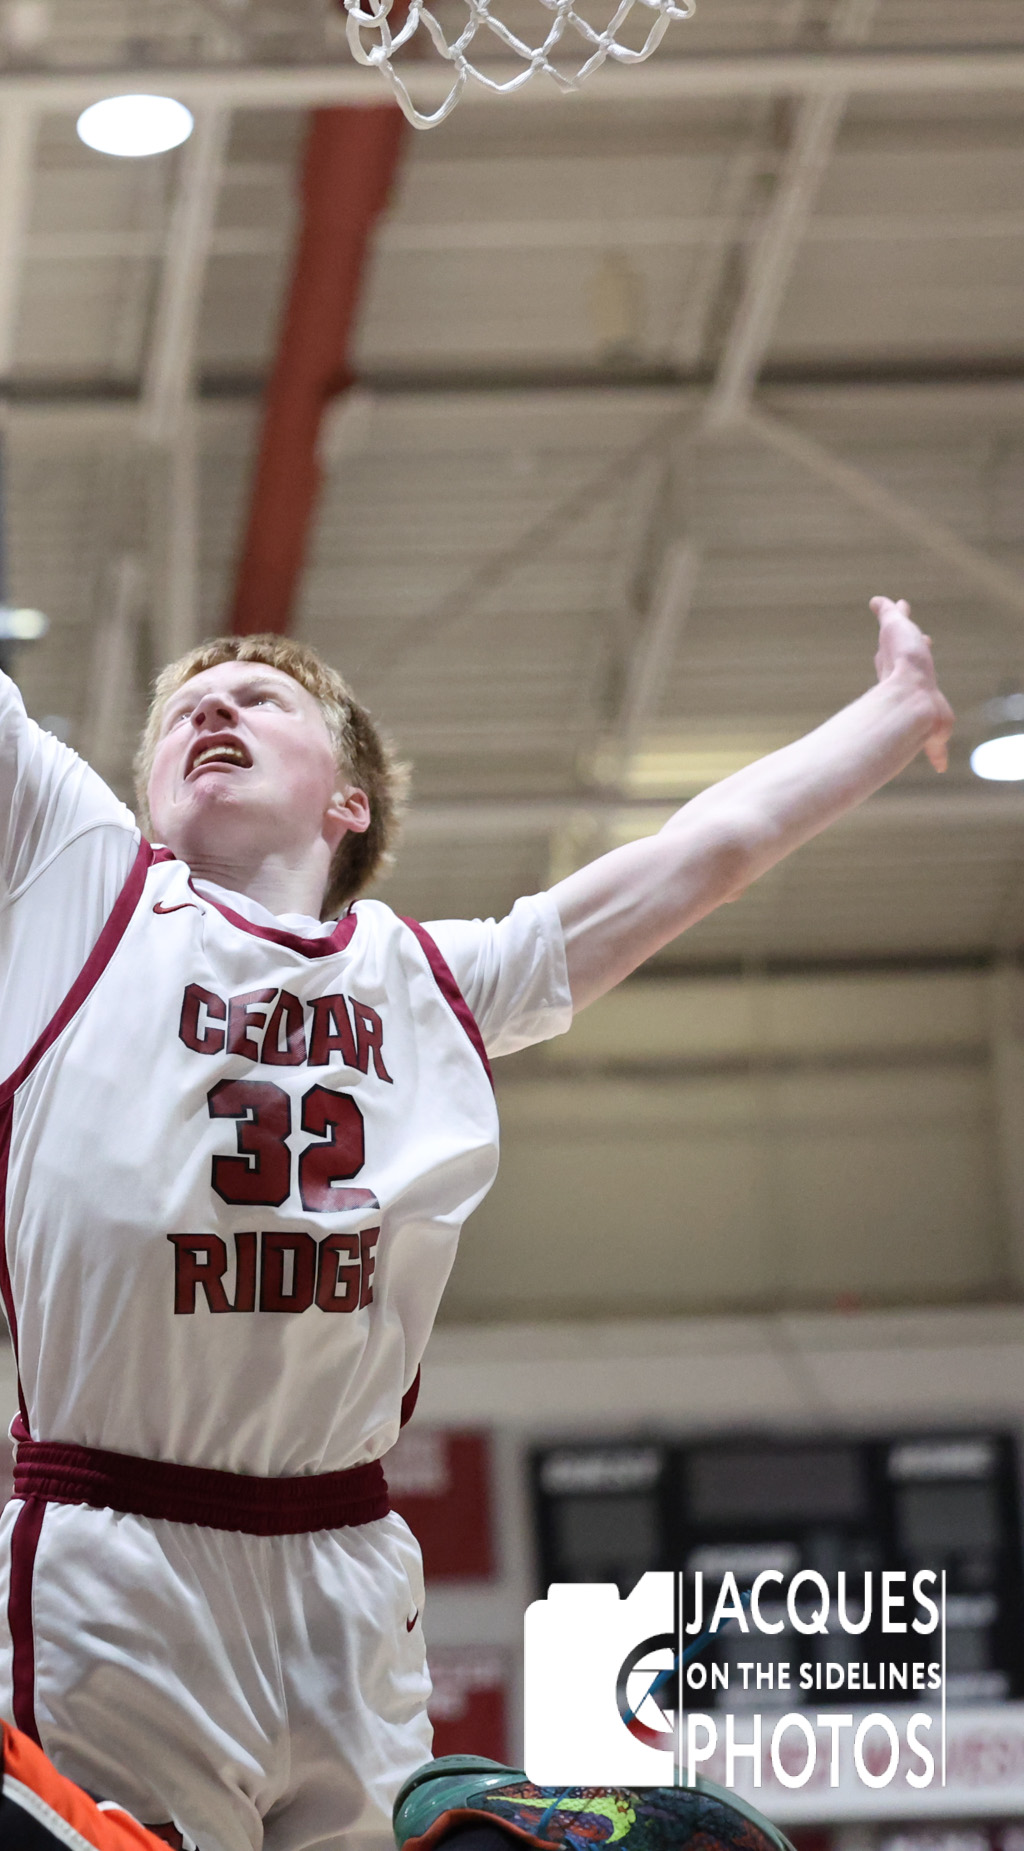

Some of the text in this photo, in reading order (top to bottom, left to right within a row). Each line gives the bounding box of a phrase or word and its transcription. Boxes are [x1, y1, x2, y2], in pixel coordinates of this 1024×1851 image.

[178, 983, 394, 1085] CEDAR
[207, 1078, 381, 1213] 32
[167, 1226, 381, 1315] RIDGE
